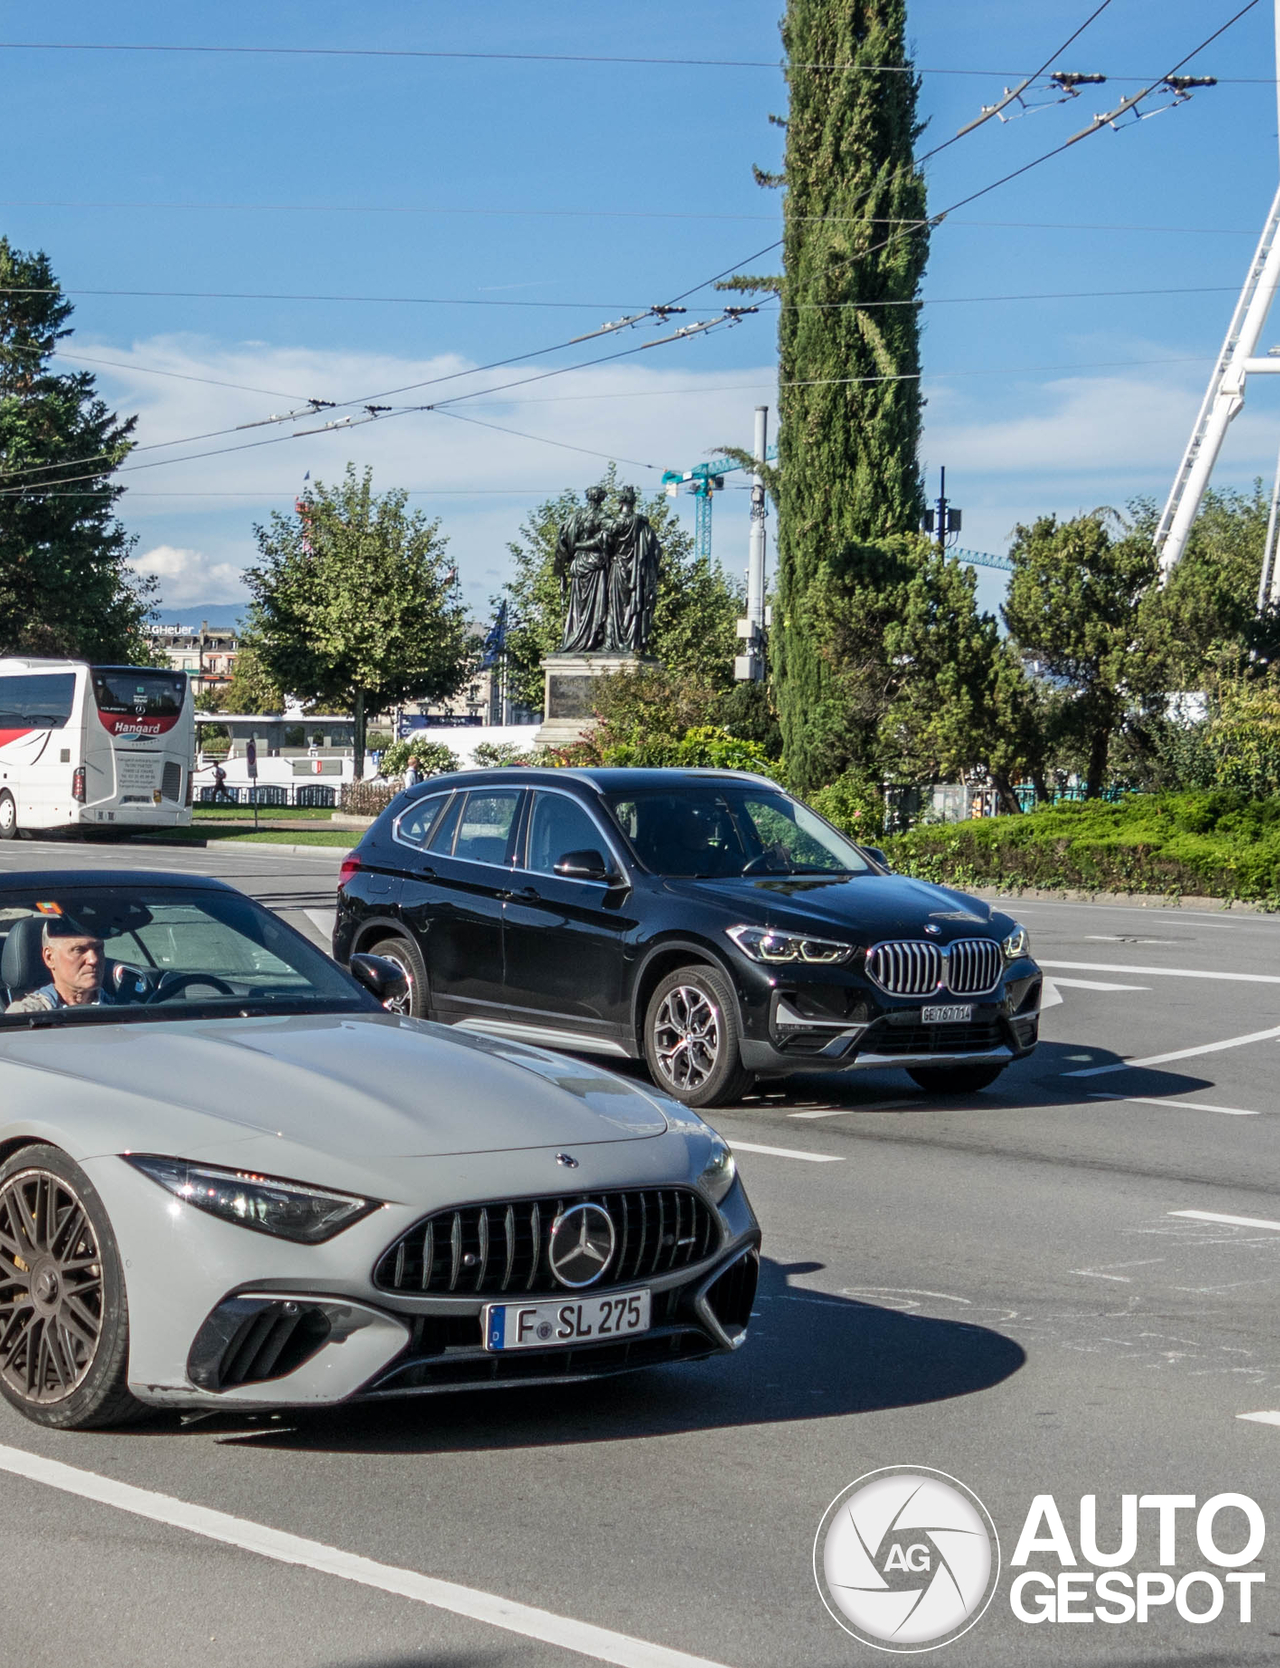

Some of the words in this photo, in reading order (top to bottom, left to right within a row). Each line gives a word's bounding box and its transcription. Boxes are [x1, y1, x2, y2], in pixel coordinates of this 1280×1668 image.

[115, 722, 161, 736] Hangard
[516, 1308, 537, 1343] F
[556, 1305, 592, 1339] SL
[598, 1296, 641, 1334] 275
